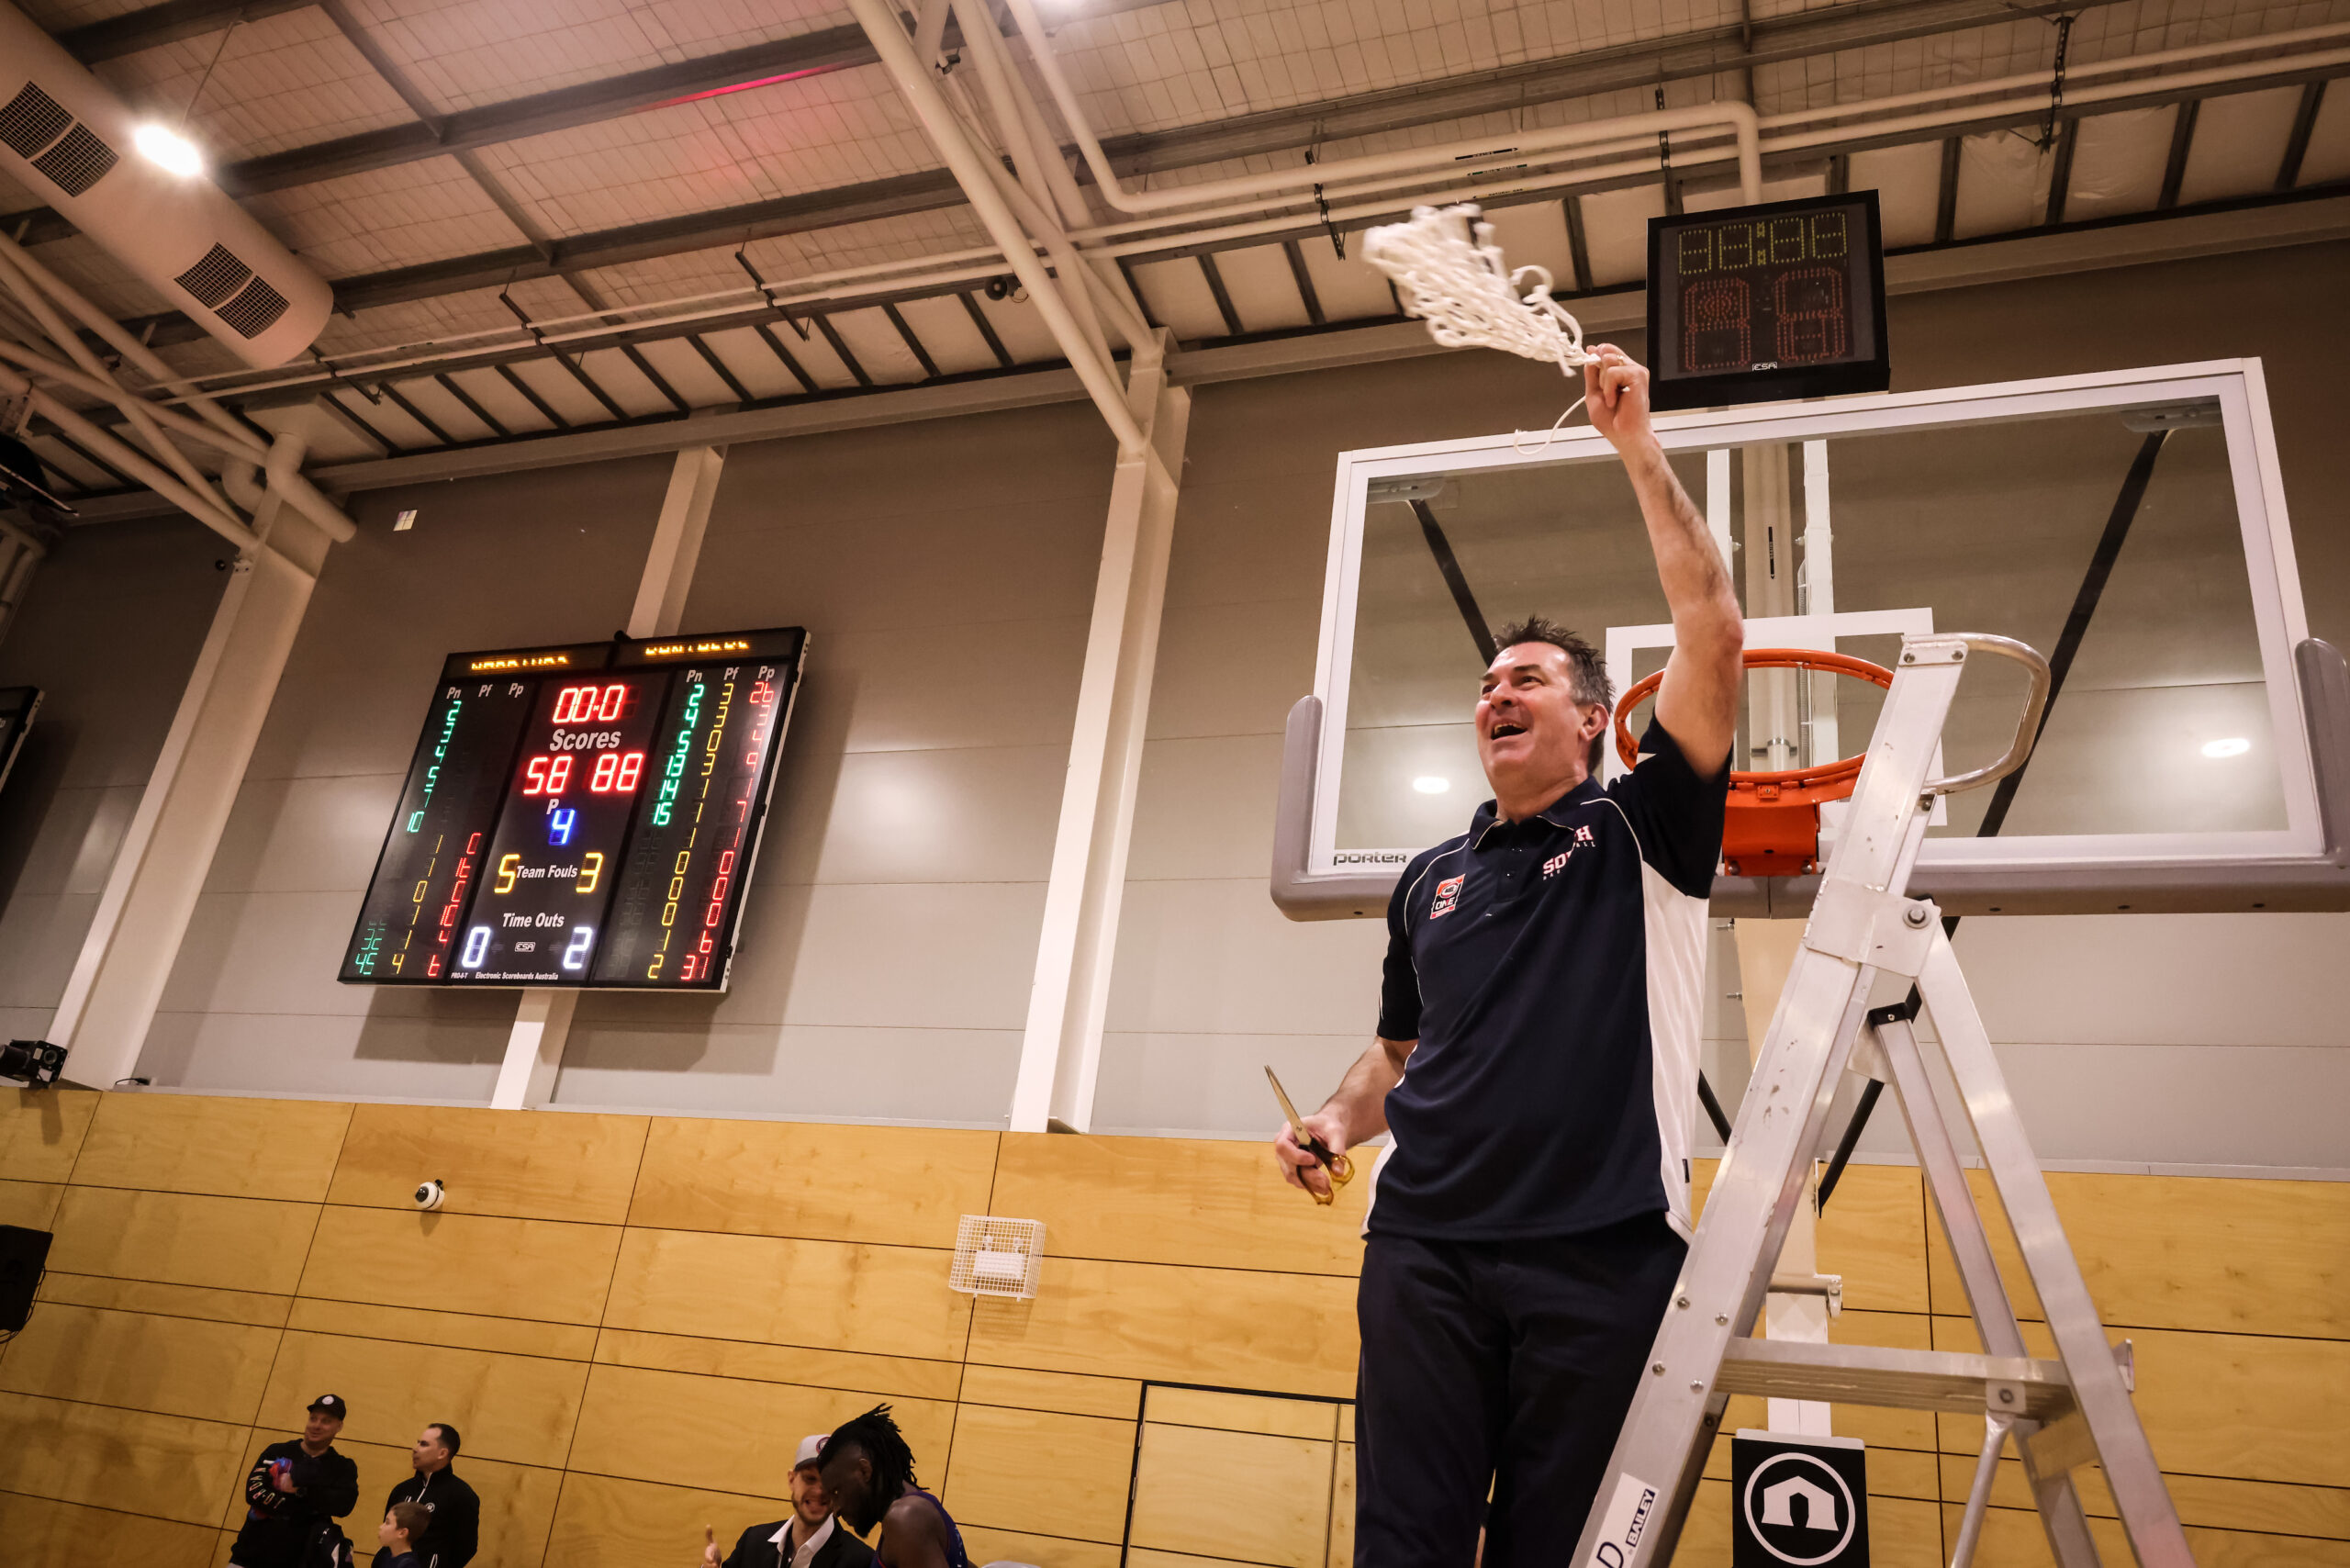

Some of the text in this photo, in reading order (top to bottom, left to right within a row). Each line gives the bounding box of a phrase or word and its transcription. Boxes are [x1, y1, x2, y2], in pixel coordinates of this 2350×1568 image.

[687, 666, 775, 682] Pn Pf Pp
[446, 683, 524, 700] Pn Pf Pp
[688, 681, 775, 707] 2 3 26
[447, 700, 462, 722] 2
[685, 705, 770, 728] 4 3 3
[441, 722, 454, 743] 3
[550, 729, 621, 751] Scores
[677, 730, 764, 753] 5 0 4
[435, 745, 446, 764] 4
[666, 752, 758, 777] 13 3 9
[426, 767, 440, 787] 5
[523, 753, 644, 794] 58 88
[660, 778, 754, 800] 14 1 1
[546, 799, 559, 814] P
[653, 801, 747, 825] 15 1 7
[551, 809, 576, 845] 4
[689, 827, 741, 848] 1 1
[436, 834, 443, 854] 1
[1543, 825, 1594, 875] SOH
[428, 857, 435, 877] 1
[494, 852, 604, 894] 5 Team Fouls 3
[675, 851, 734, 874] 0 0
[413, 880, 428, 902] 0
[668, 877, 728, 901] 0 0
[412, 905, 420, 925] 1
[502, 913, 565, 927] Time Outs
[661, 902, 722, 926] 0 0
[405, 930, 412, 949] 1
[462, 926, 593, 969] 0 ESA 2
[663, 930, 671, 951] 1
[392, 954, 405, 974] 4
[647, 954, 709, 980] 2 31
[476, 971, 501, 980] Electronic
[502, 972, 534, 980] Scoreboards
[535, 972, 558, 980] Australia
[1626, 1489, 1655, 1548] BAILEY
